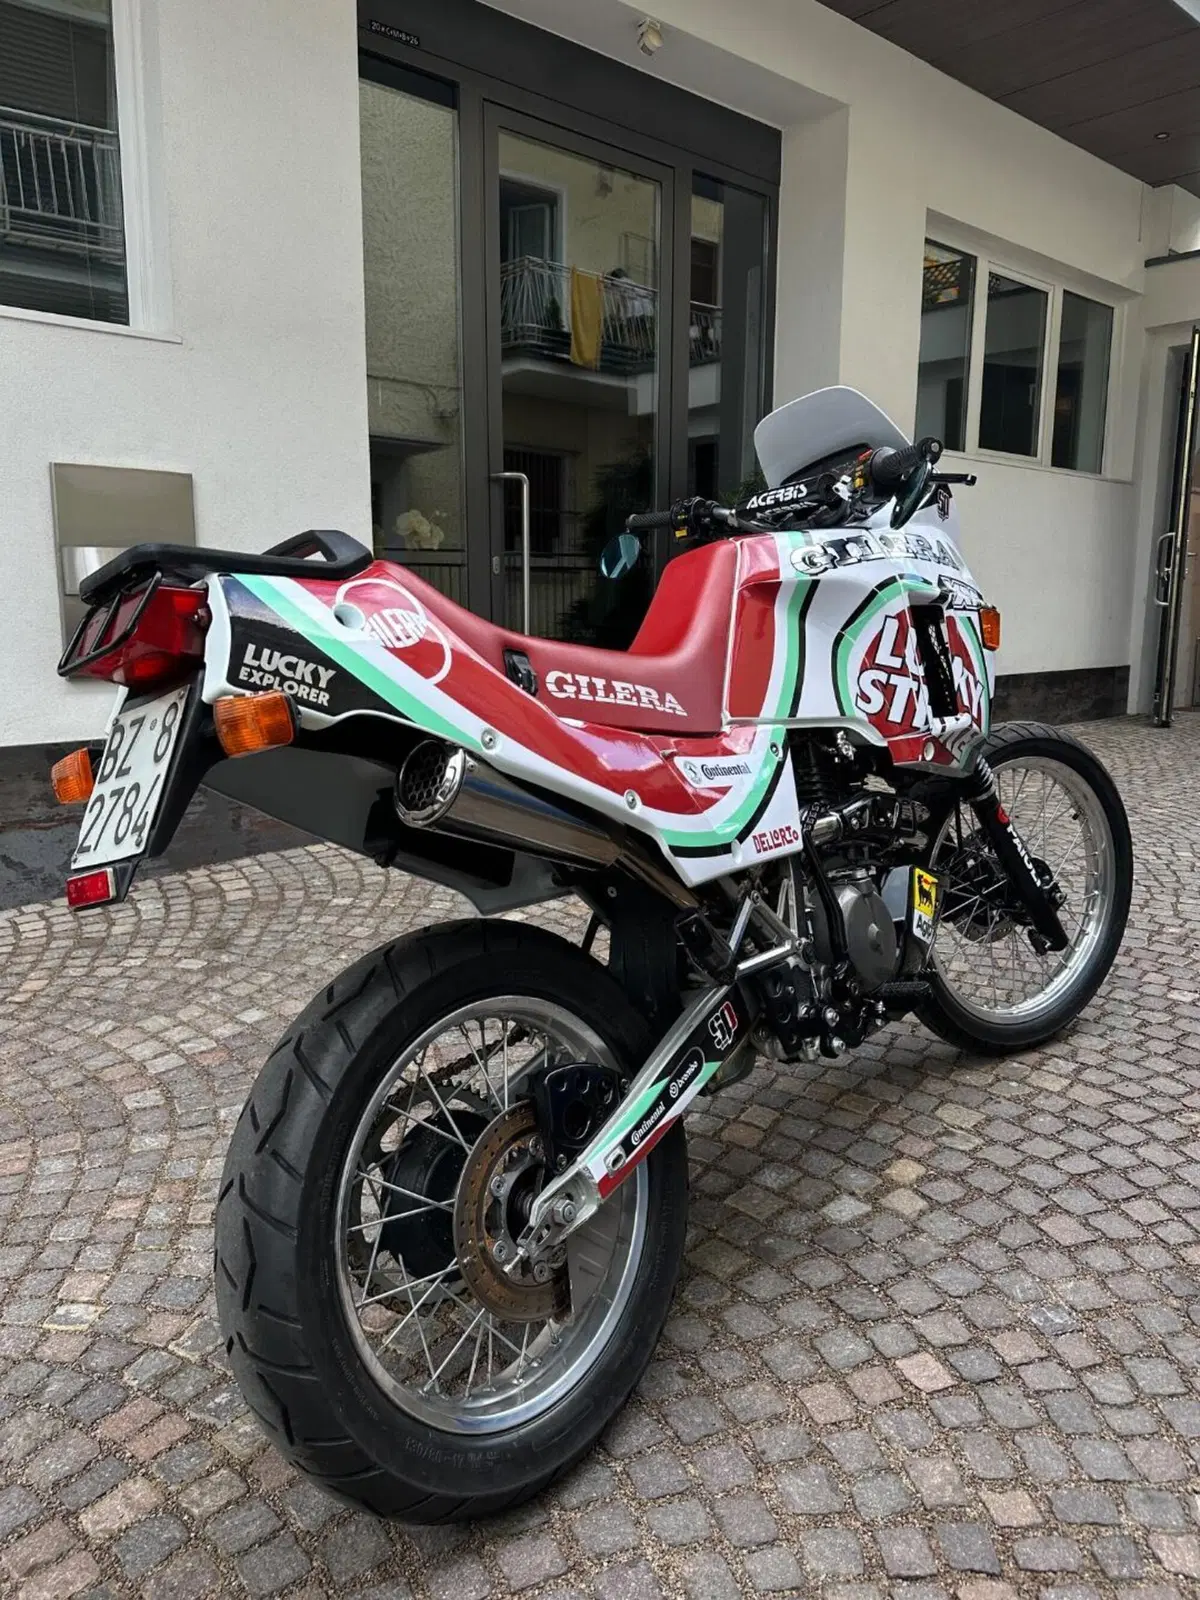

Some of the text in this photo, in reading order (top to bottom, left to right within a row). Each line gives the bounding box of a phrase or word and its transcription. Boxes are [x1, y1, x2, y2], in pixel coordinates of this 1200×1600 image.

[238, 666, 330, 707] EXPLORER
[243, 643, 337, 689] LUCKY
[874, 616, 985, 720] LUKY
[545, 670, 688, 717] GILERA
[98, 701, 178, 785] BZ 8
[701, 762, 752, 780] Continental
[78, 774, 160, 854] 2784
[631, 1101, 666, 1146] Continental
